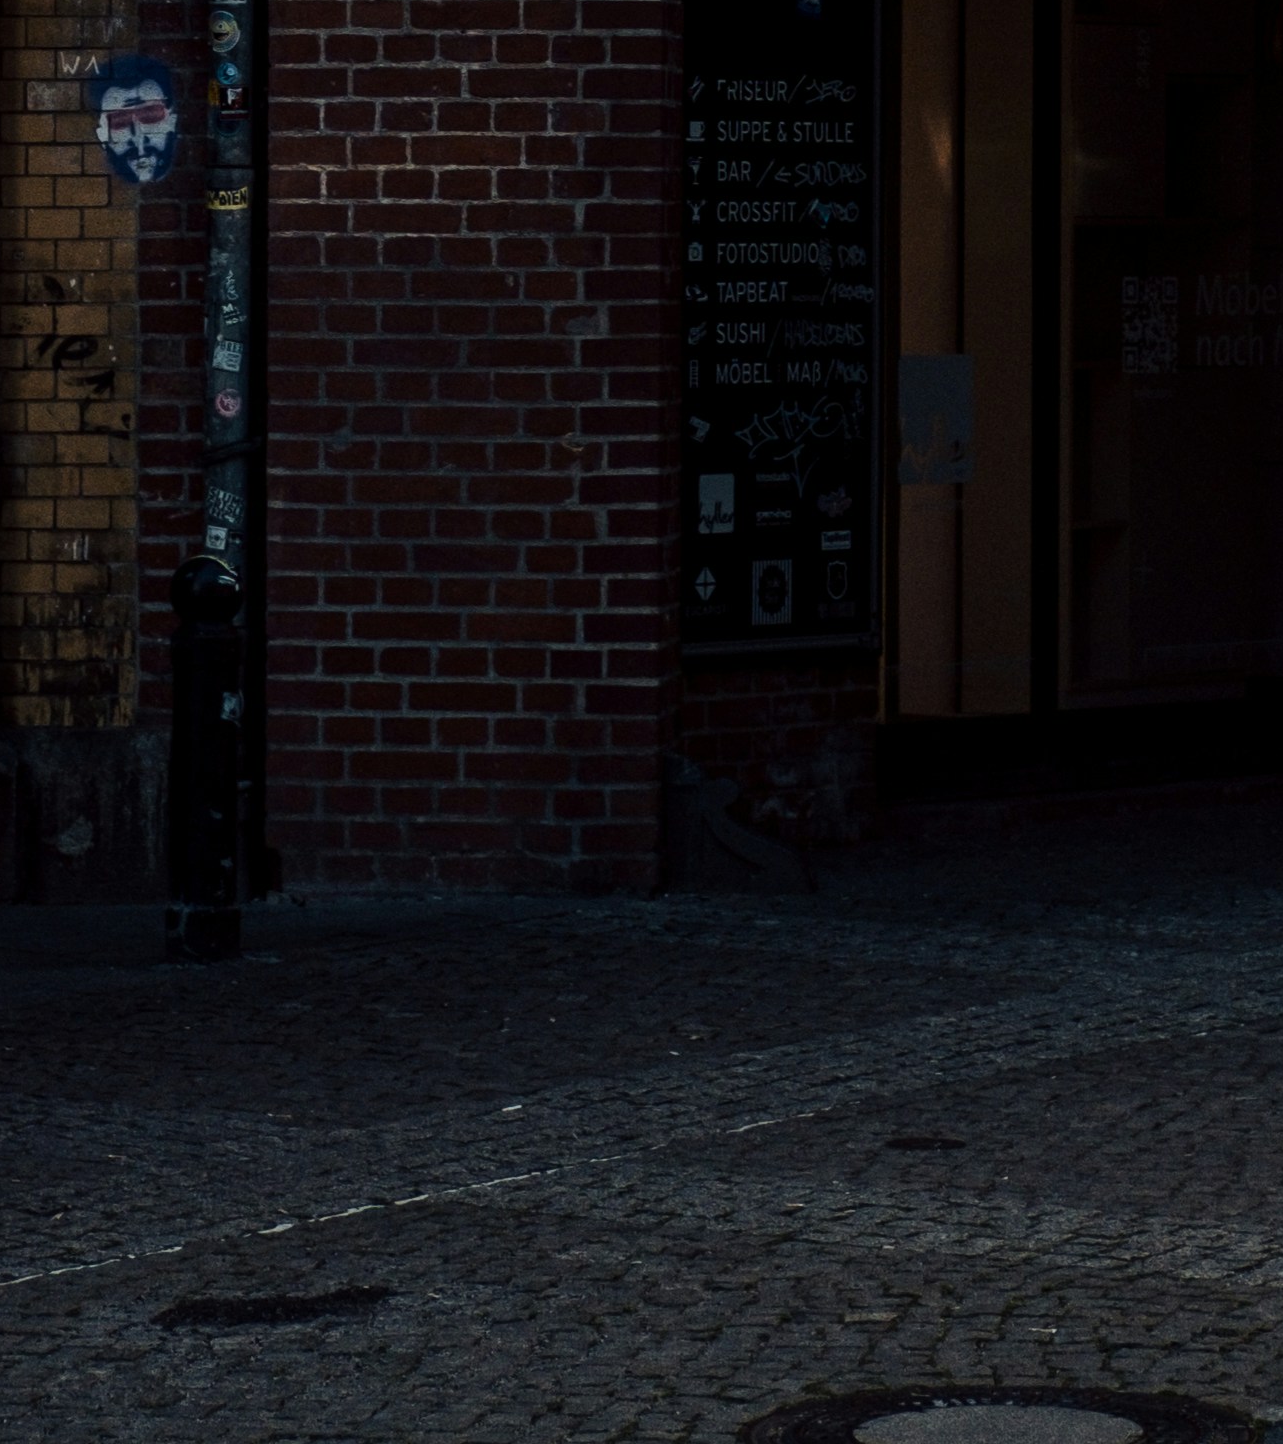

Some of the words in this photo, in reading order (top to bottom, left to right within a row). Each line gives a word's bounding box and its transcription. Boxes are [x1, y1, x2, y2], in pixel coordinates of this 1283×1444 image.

[716, 120, 772, 142] SUPPE
[776, 120, 789, 143] &
[792, 121, 855, 143] STULLE
[716, 160, 752, 182] BAR
[716, 201, 797, 223] CROSSFIT
[716, 242, 819, 265] FOTOSTUDIO
[716, 281, 789, 304] TAPBEAT
[716, 322, 766, 345] SUSHI
[1196, 322, 1265, 367] nach
[715, 357, 773, 385] MÖBEL
[786, 360, 822, 388] MAß
